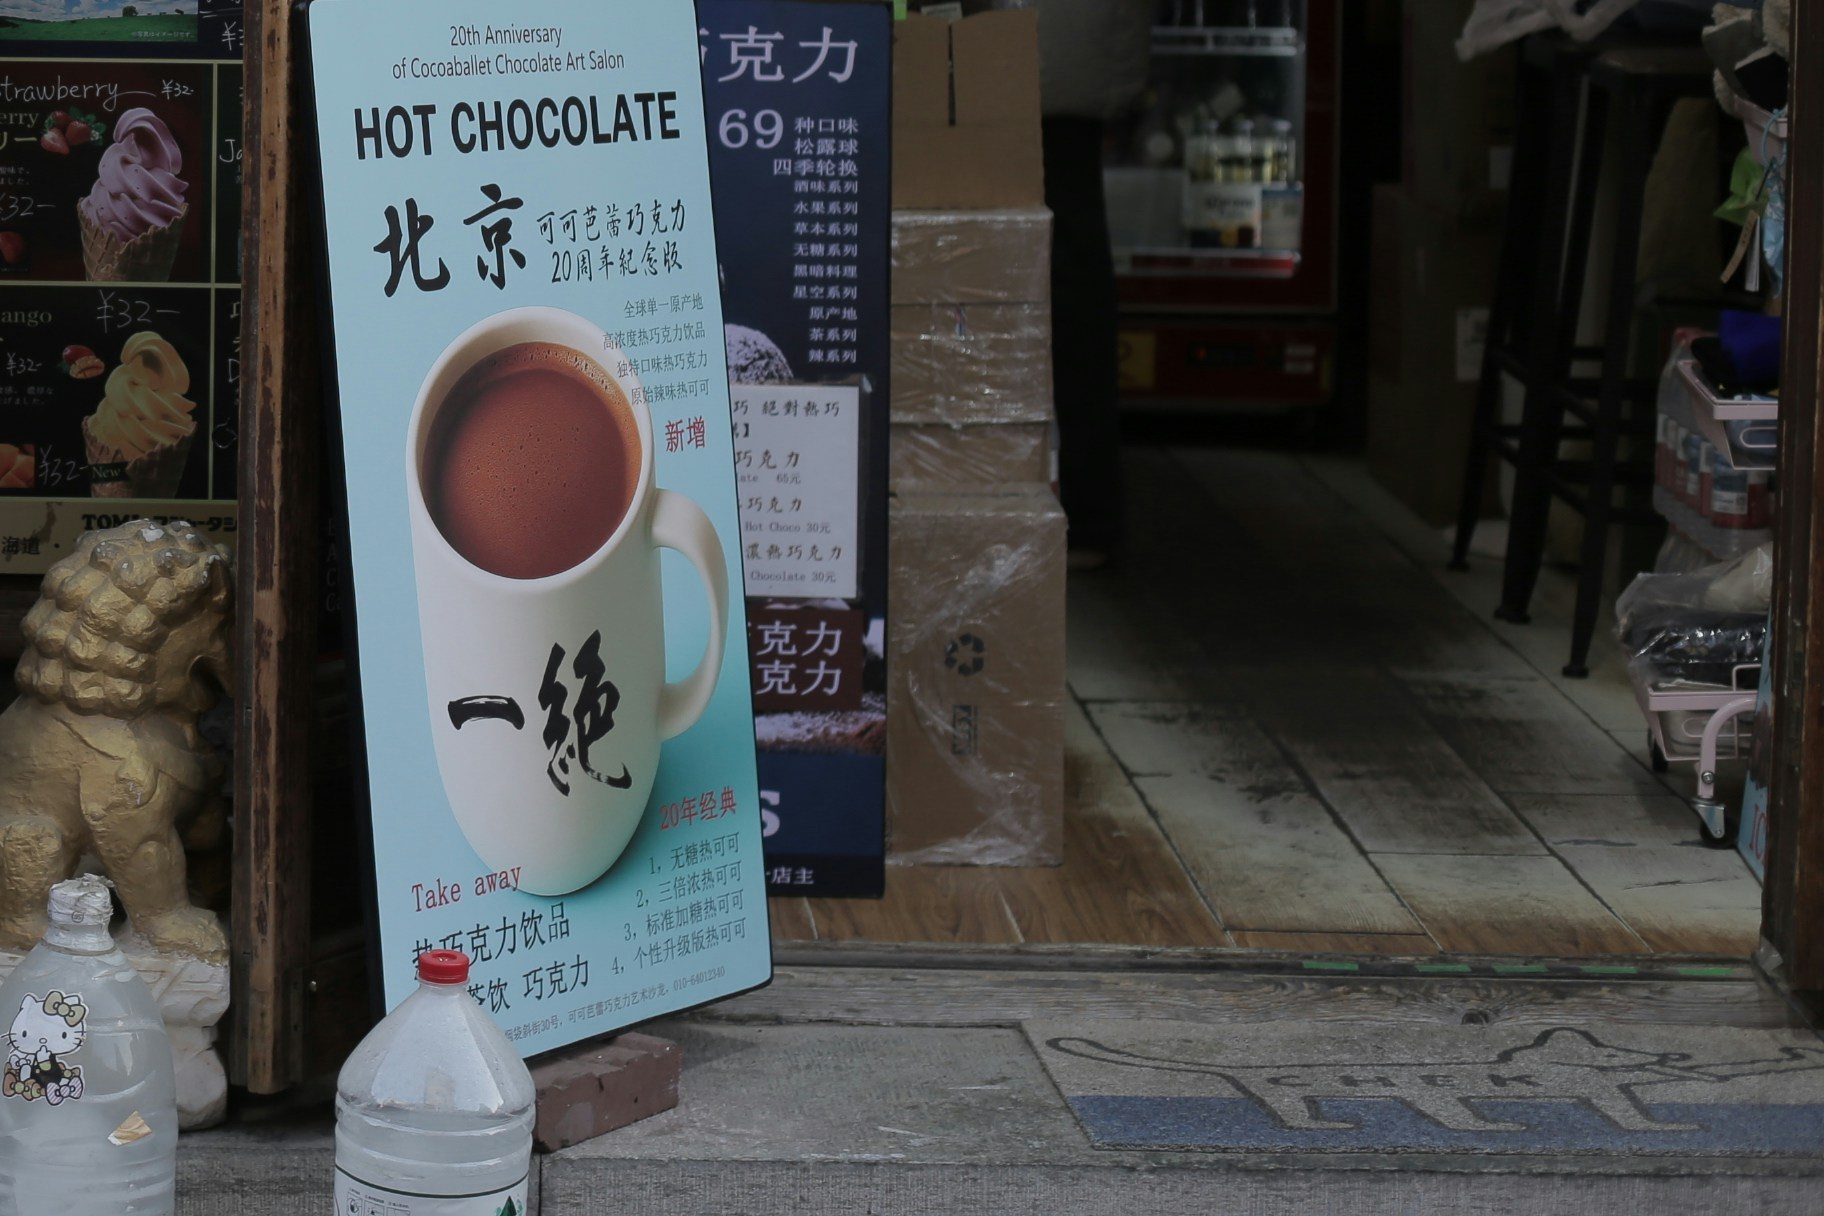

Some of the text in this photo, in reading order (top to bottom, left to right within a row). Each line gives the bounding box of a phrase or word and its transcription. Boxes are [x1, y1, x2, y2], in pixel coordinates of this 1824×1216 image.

[449, 23, 563, 51] 20th Anniversary
[392, 48, 626, 79] of Cocoaballet Chocolate Art Salon
[354, 90, 681, 161] HOT CHOCOLATE
[717, 108, 783, 149] 69
[794, 116, 859, 135] 种口味
[794, 138, 859, 156] 松露球
[773, 158, 859, 177] 四季轮换
[793, 201, 858, 215] 水果系列
[536, 198, 687, 246] 可可芭蕾巧克力
[373, 182, 527, 298] 北京
[793, 243, 858, 257] 无糖系列
[623, 292, 704, 319] 全球单一原产地
[793, 285, 858, 299] 星空系列
[808, 306, 858, 320] 原产地
[603, 320, 706, 352] 高浓度热巧克力饮品
[809, 328, 858, 342] 茶系列
[616, 349, 709, 379] 独特口味热巧克力
[808, 349, 858, 363] 辣系列
[630, 377, 711, 406] 原始辣味热可可
[665, 416, 706, 454] 新增
[90, 466, 122, 480] New
[745, 521, 832, 534] Hot Choco 30元
[750, 570, 837, 584] Chocolate 30元
[658, 785, 737, 832] 20年经典
[411, 865, 522, 914] Take away
[522, 953, 590, 1003] 巧克力
